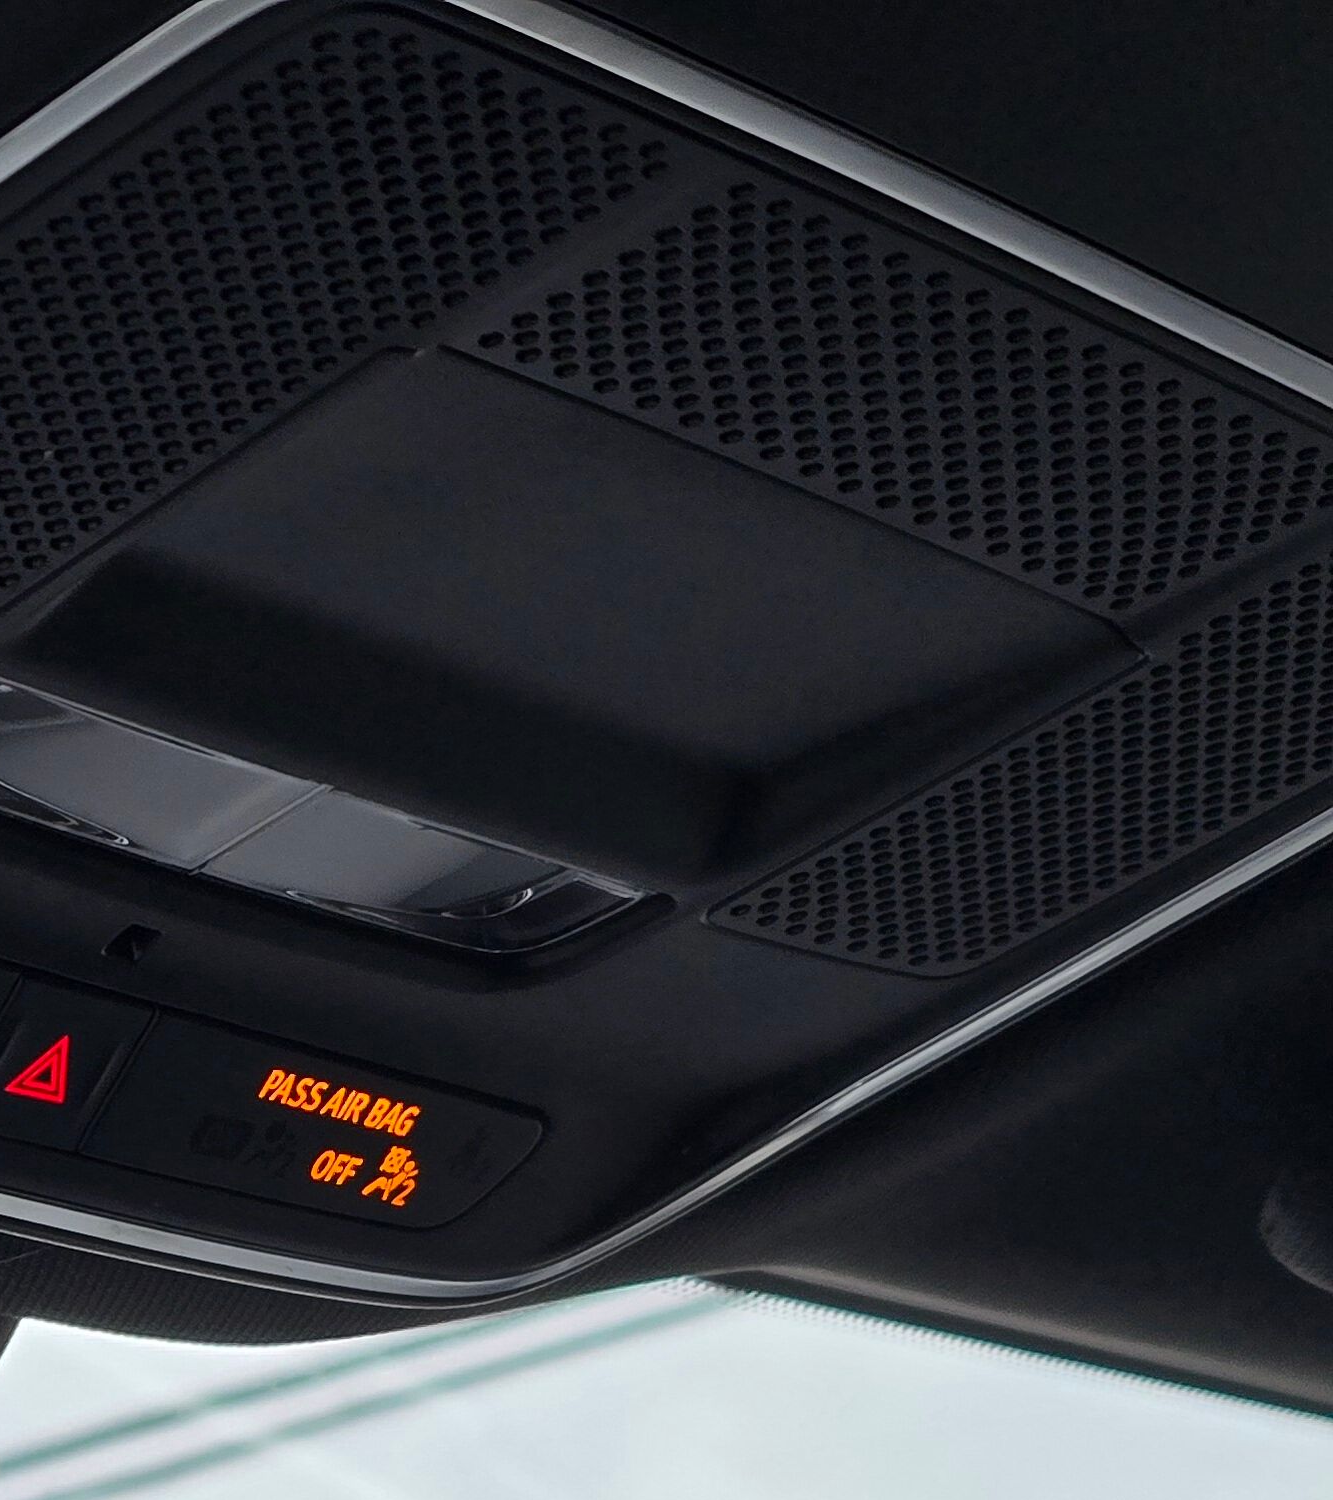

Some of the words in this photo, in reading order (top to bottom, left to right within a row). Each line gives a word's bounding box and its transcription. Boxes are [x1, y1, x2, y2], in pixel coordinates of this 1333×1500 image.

[258, 1069, 330, 1111] PASS
[319, 1086, 371, 1124] AIR
[363, 1098, 421, 1137] BAG
[310, 1150, 364, 1185] OFF
